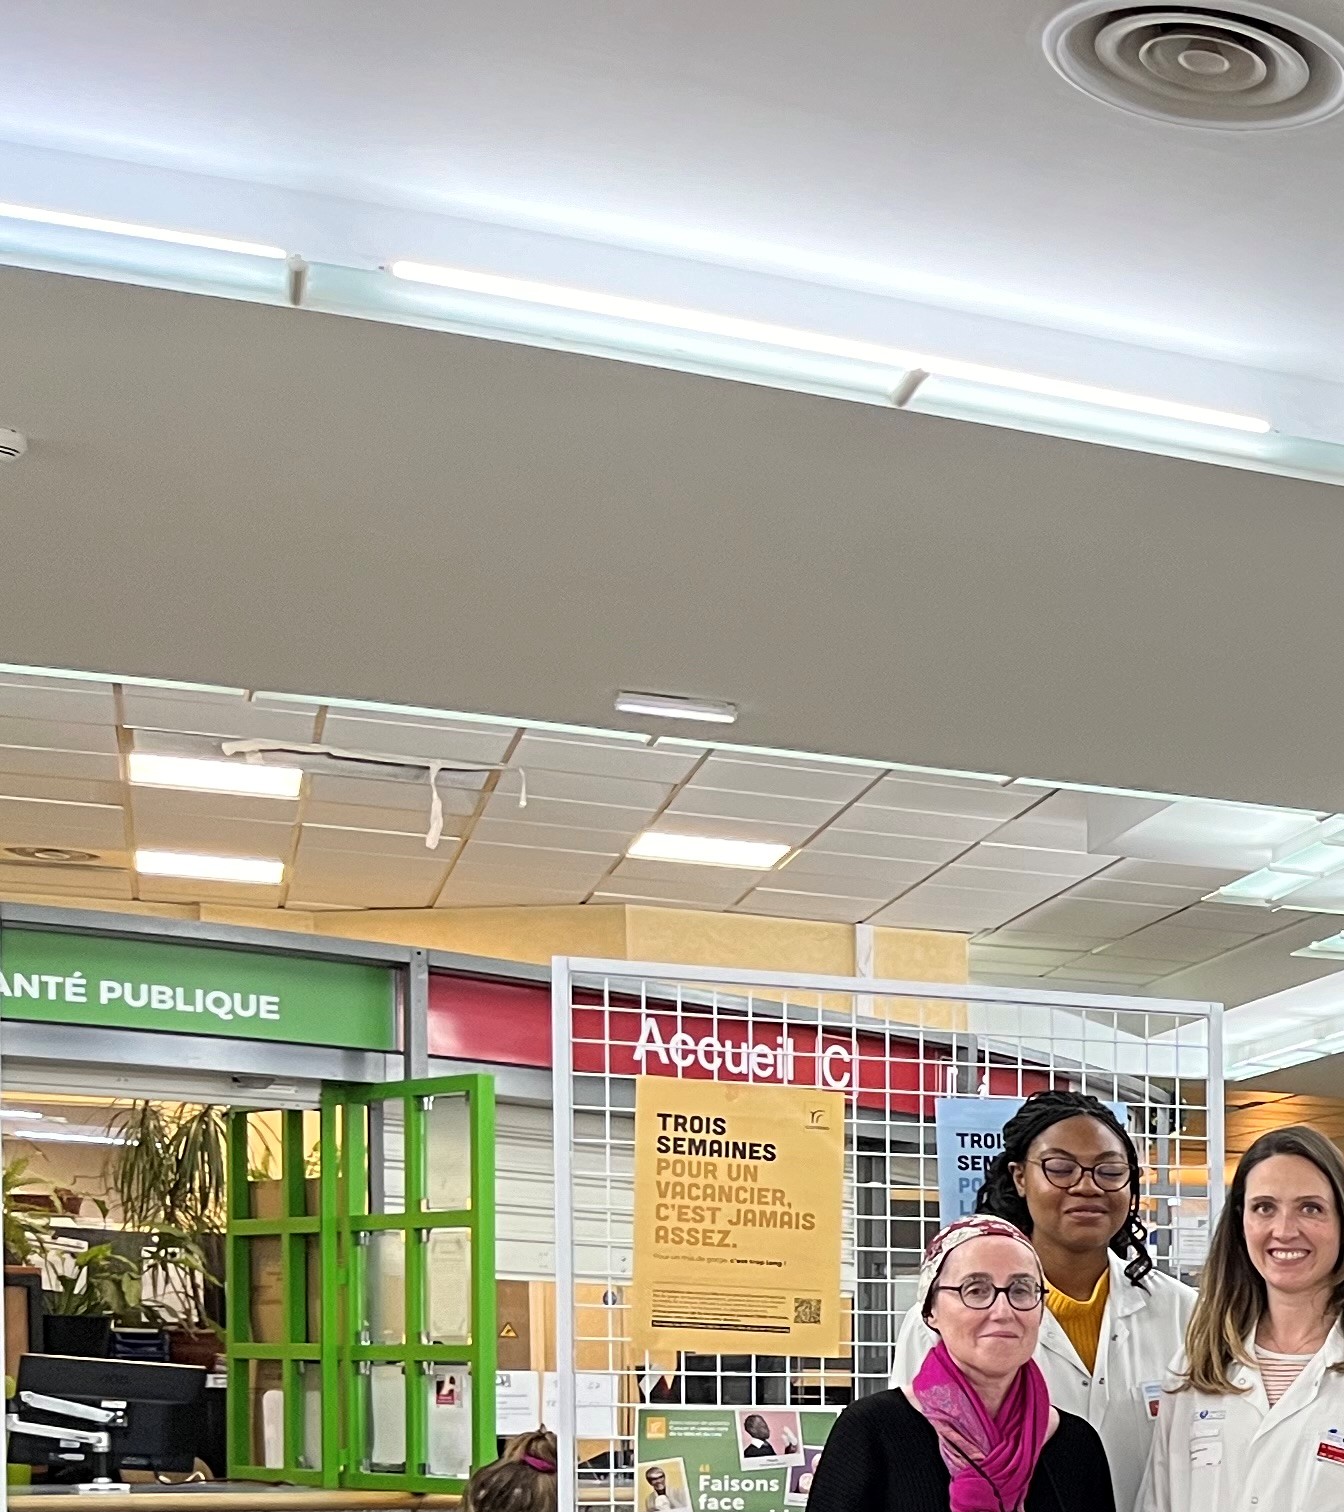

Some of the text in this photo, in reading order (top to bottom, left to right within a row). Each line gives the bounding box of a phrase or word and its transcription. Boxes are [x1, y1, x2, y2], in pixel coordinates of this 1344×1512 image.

[0, 971, 280, 1020] ANTÉ PUBLIQUE
[633, 1017, 851, 1089] Accueil C
[656, 1113, 727, 1135] TROIS
[656, 1136, 777, 1161] SEMAINES
[956, 1132, 1002, 1149] TROI
[656, 1158, 758, 1182] POUR UN
[655, 1180, 792, 1209] VACANCIER,
[655, 1203, 816, 1230] C'EST JAMAIS
[654, 1225, 738, 1248] ASSEZ.
[698, 1475, 780, 1492] Faisons
[698, 1493, 745, 1511] face
